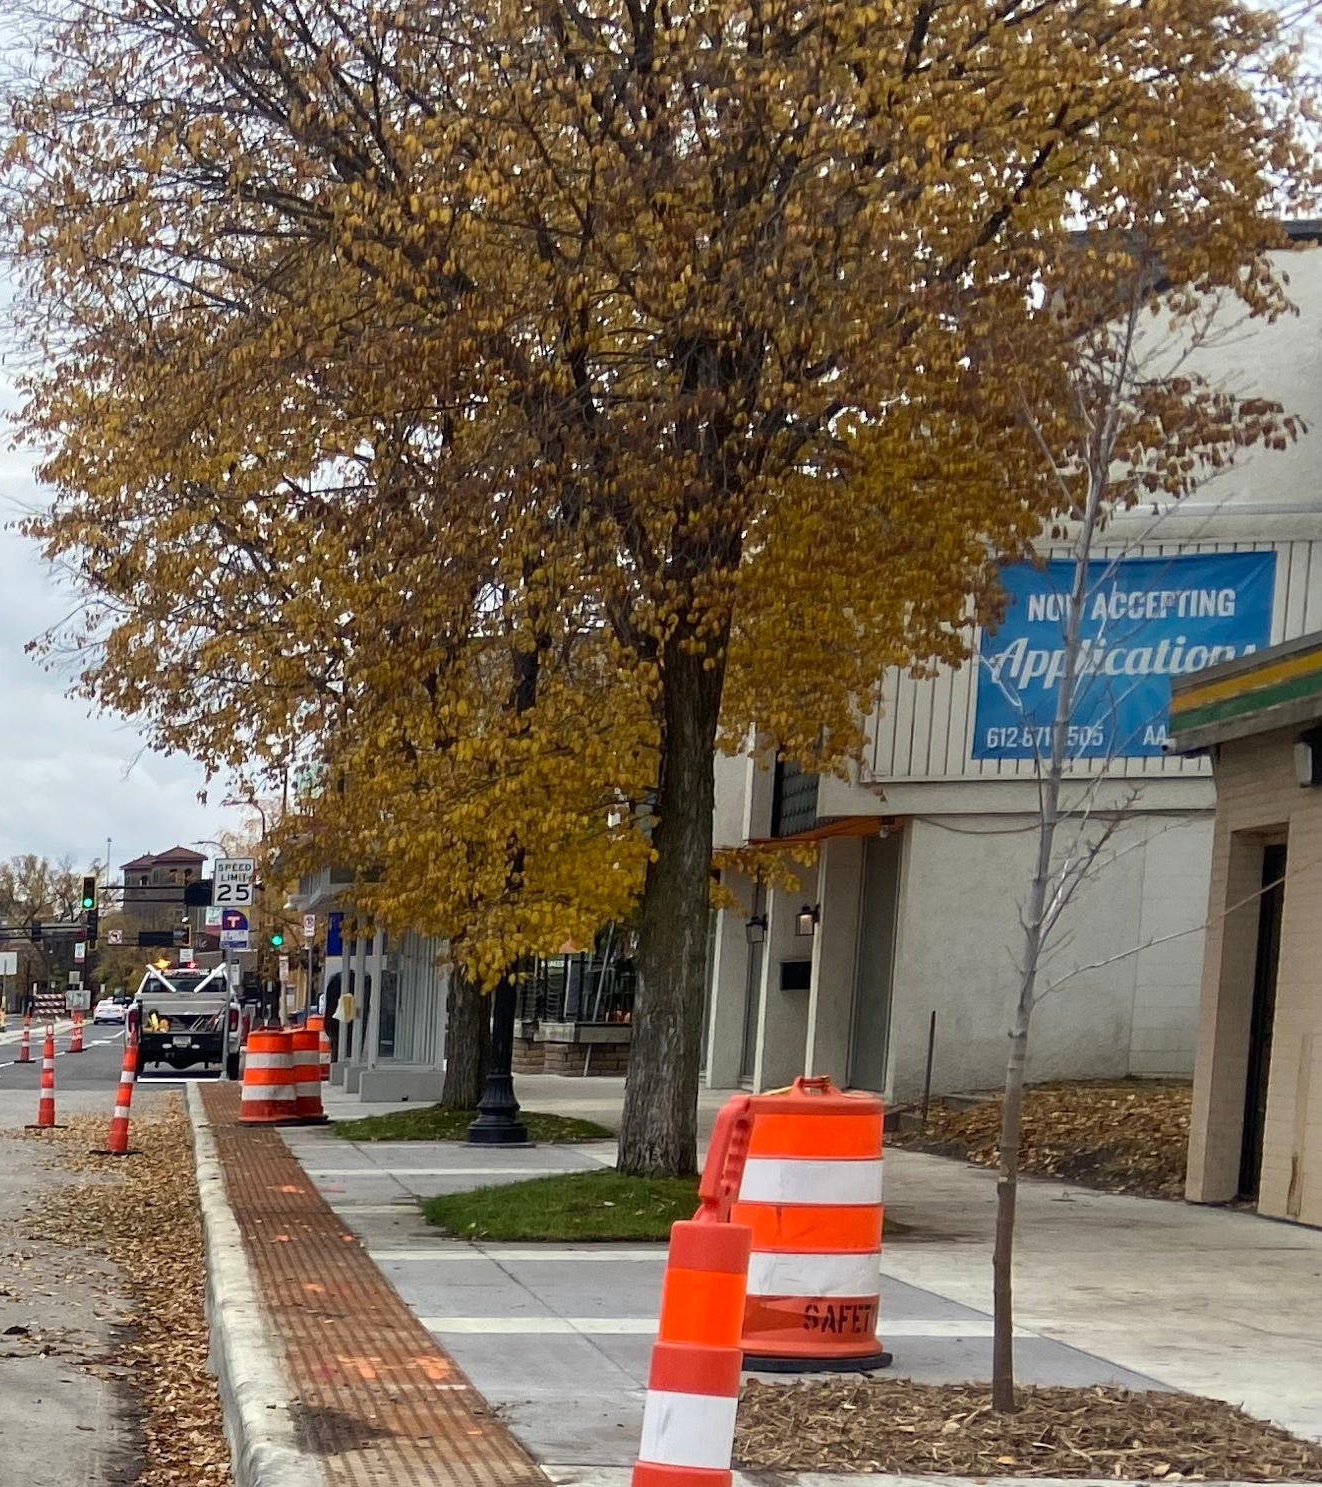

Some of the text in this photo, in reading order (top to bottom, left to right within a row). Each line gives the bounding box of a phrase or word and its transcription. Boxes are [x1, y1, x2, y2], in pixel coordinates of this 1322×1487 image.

[1091, 588, 1236, 620] ACCEPTING
[989, 635, 1257, 690] Application
[217, 863, 252, 872] SPEED
[220, 873, 247, 882] LIMIT
[216, 884, 250, 901] 25
[227, 916, 240, 928] T
